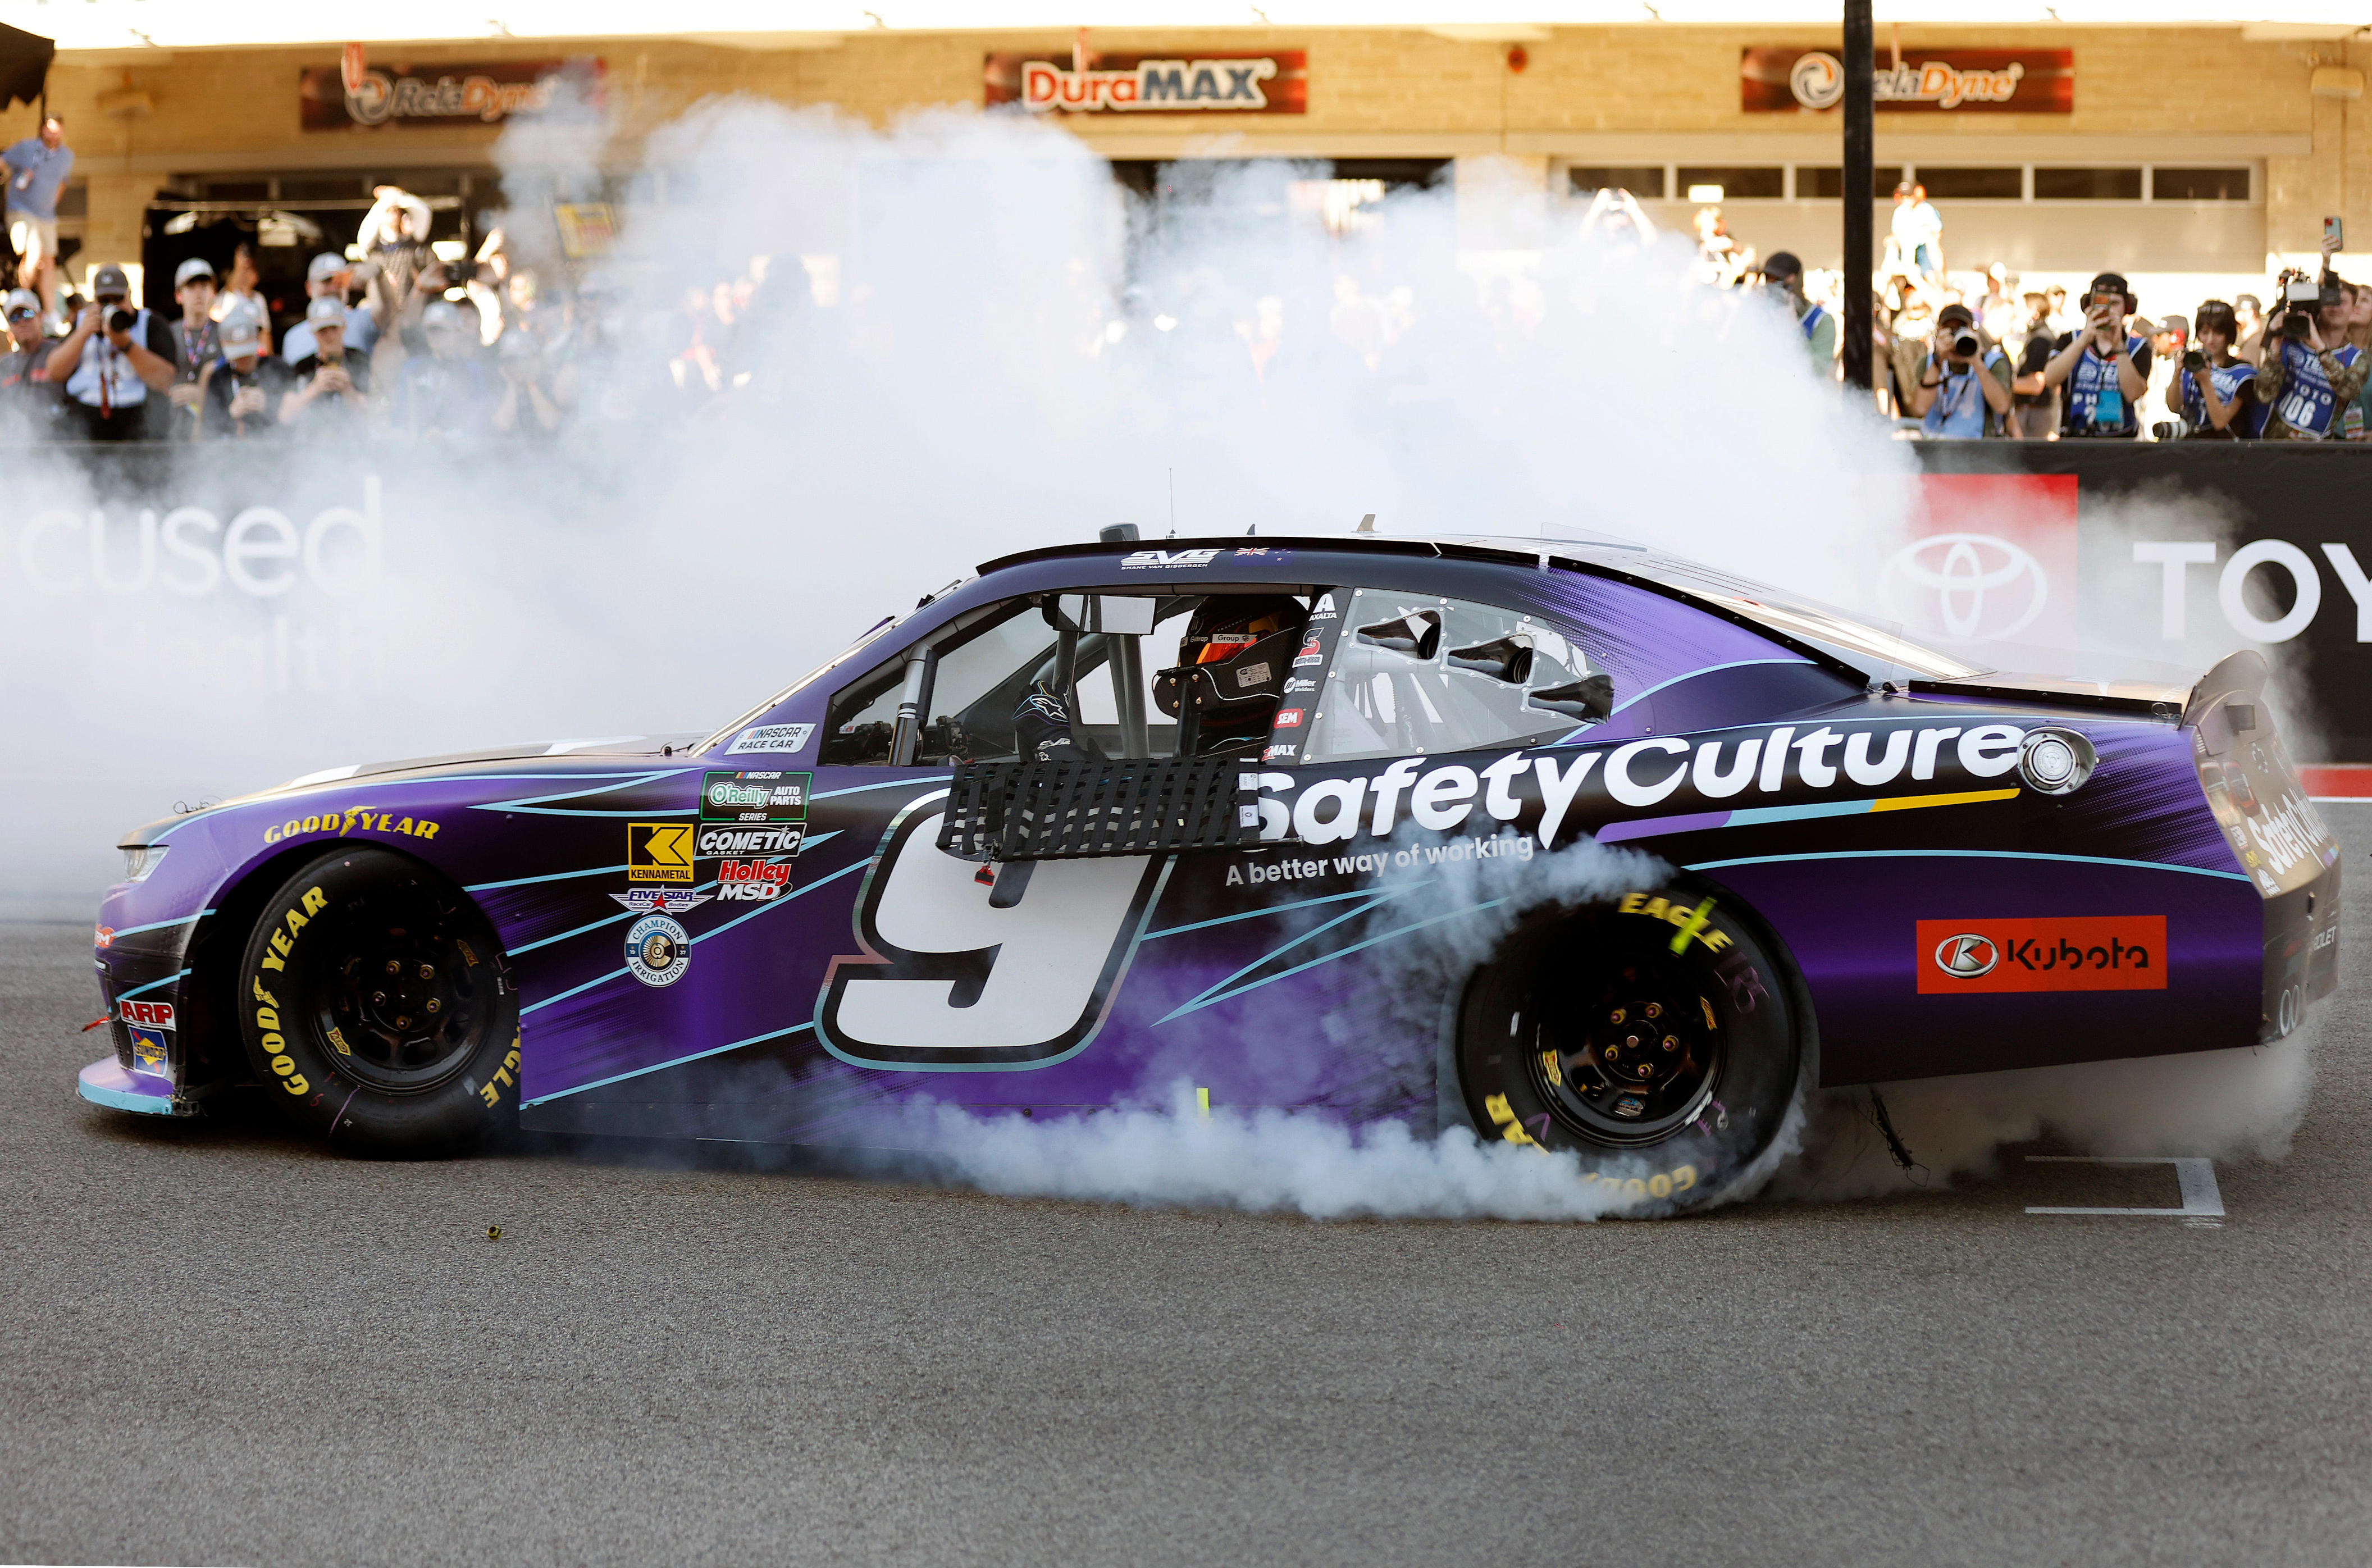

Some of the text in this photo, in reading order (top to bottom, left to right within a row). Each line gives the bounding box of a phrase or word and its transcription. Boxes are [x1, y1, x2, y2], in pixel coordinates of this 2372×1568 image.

[1024, 61, 1262, 108] DuraMAX
[1873, 62, 2016, 108] elaDyne
[0, 475, 383, 596] cused
[1120, 548, 1226, 566] SVG
[1308, 612, 1337, 622] AXALTA
[1277, 712, 1298, 724] SEM
[756, 727, 801, 739] NASCAR
[737, 741, 768, 750] RACE
[710, 783, 772, 807] O'Reilly
[774, 786, 801, 795] AUTO
[1249, 724, 2024, 850] SafetyCulture
[770, 796, 802, 805] PARTS
[700, 831, 801, 850] COMETIC
[1225, 833, 1534, 886] A better way of working
[631, 869, 691, 879] KENNAMETAL
[718, 859, 792, 887] Holley
[630, 891, 694, 901] FIVE STAR
[717, 883, 781, 901] MSD
[632, 920, 683, 940] CHAMPION
[827, 800, 1164, 1057] 9
[2007, 937, 2150, 970] Kubota
[632, 960, 684, 982] IRRIGATION
[120, 1000, 173, 1024] ARP
